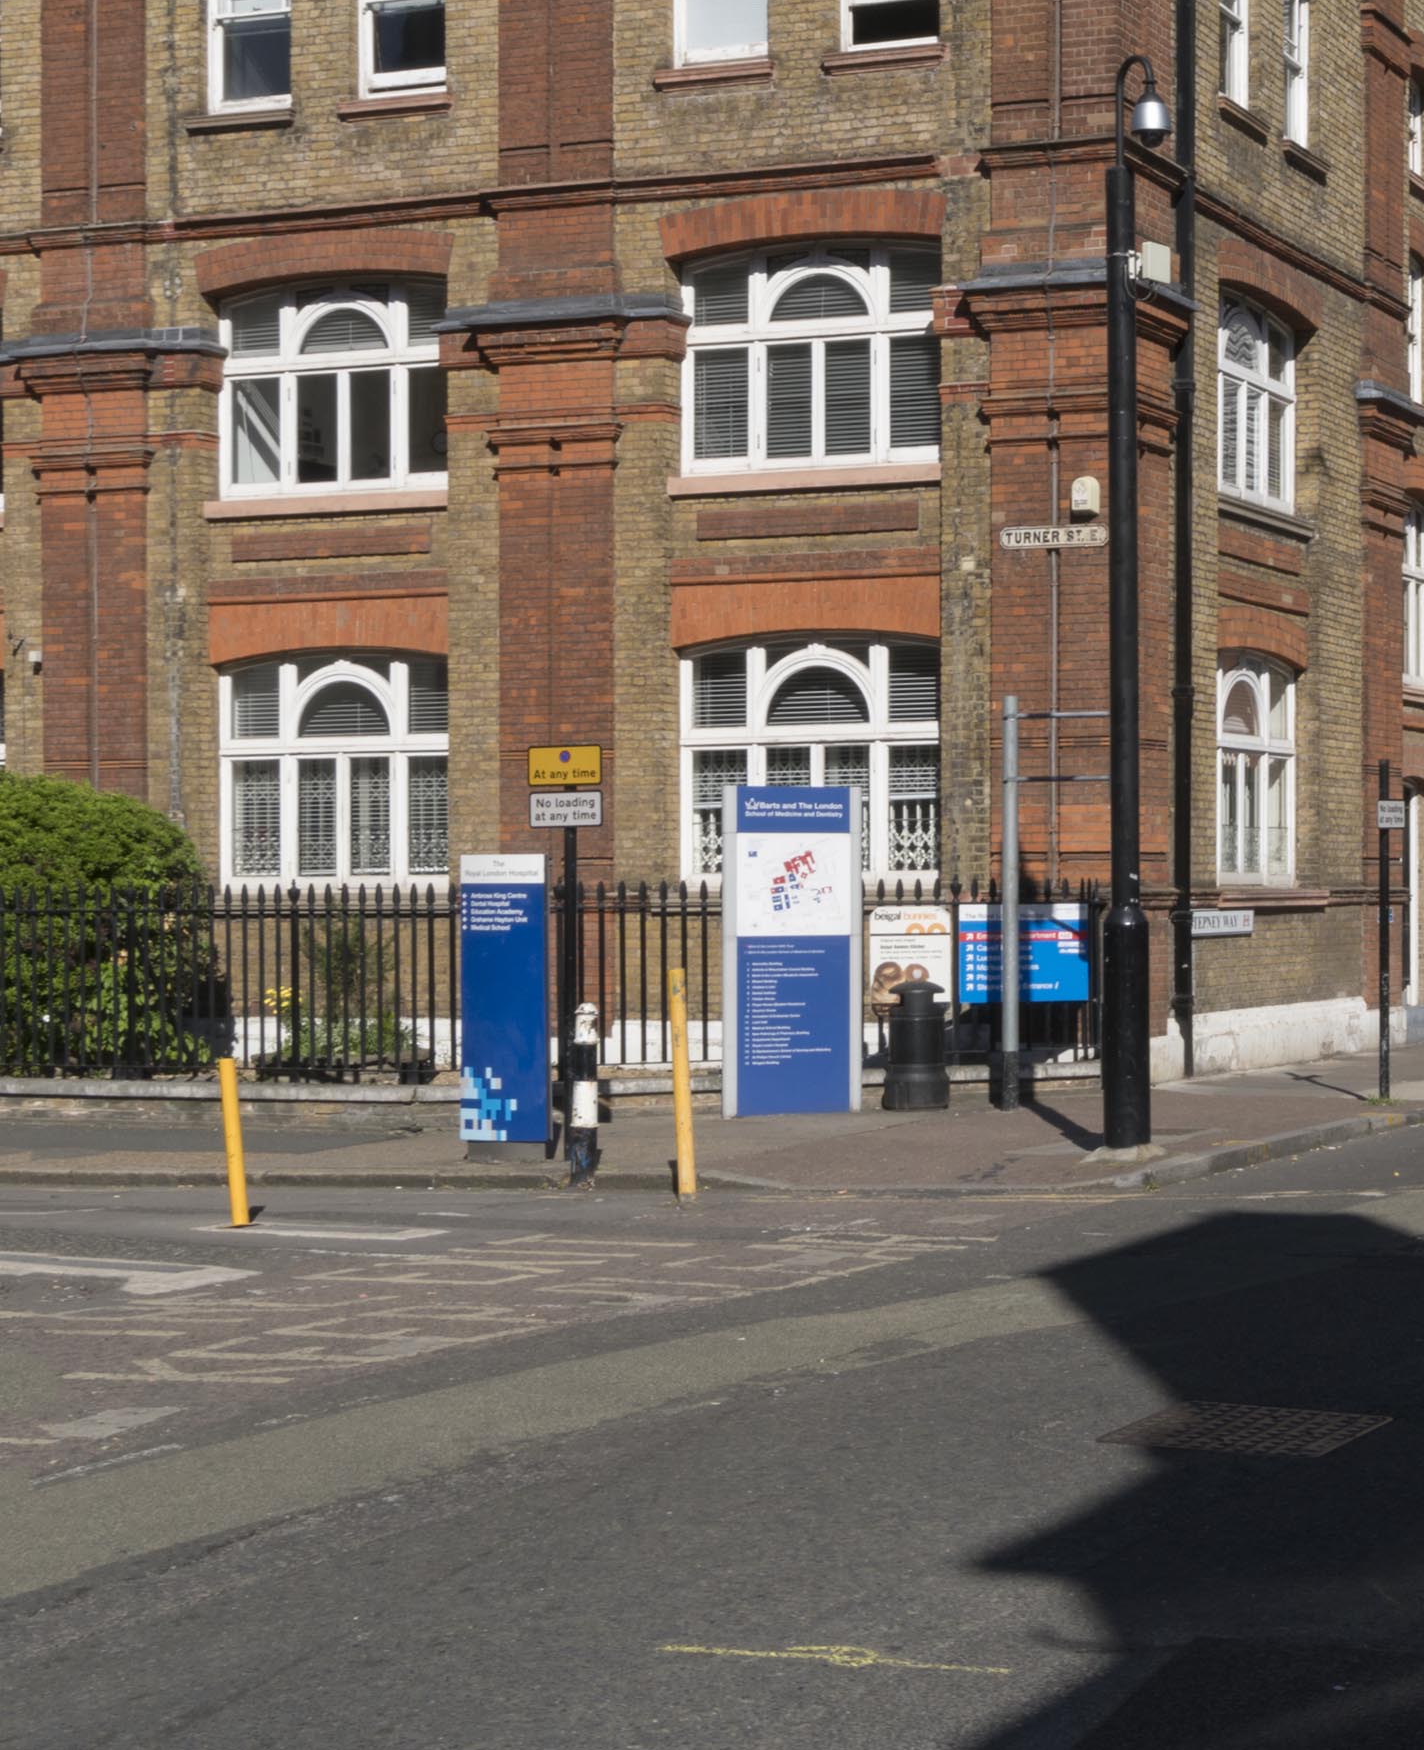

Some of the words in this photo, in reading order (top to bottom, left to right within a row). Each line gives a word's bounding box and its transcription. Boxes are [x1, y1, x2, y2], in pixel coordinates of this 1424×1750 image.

[1005, 531, 1060, 544] TURNER
[533, 769, 546, 779] At
[549, 770, 568, 781] any
[571, 768, 597, 778] time
[536, 798, 551, 808] No
[555, 797, 596, 809] loading
[759, 801, 780, 809] Barts
[782, 801, 797, 809] and
[798, 801, 813, 809] The
[814, 802, 843, 810] London
[535, 812, 546, 821] at
[549, 813, 568, 822] any
[572, 810, 597, 820] time
[873, 911, 902, 922] beigal
[1222, 914, 1239, 928] WAY
[59, 1305, 569, 1384] KEEP
